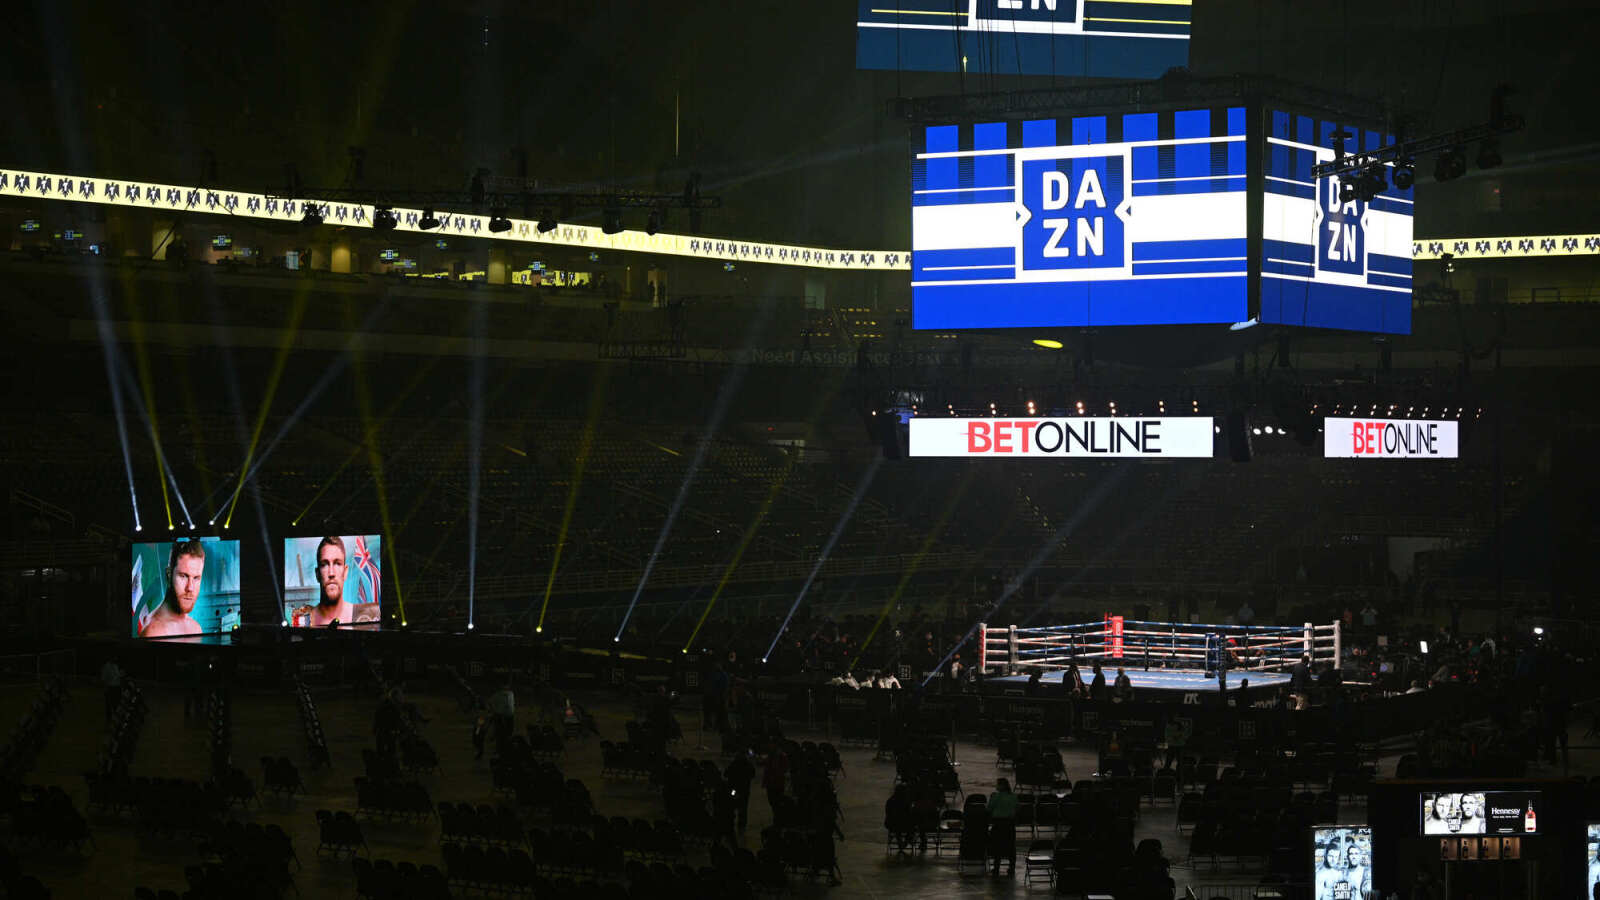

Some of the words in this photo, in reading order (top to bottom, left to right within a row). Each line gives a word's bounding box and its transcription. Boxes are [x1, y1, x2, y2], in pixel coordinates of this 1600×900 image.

[1042, 169, 1107, 211] DA
[1042, 216, 1104, 258] ZN
[1327, 221, 1356, 263] ZN
[966, 420, 1162, 453] BETONLINE
[1352, 421, 1438, 454] BETONLINE
[1491, 807, 1520, 816] Hennessy
